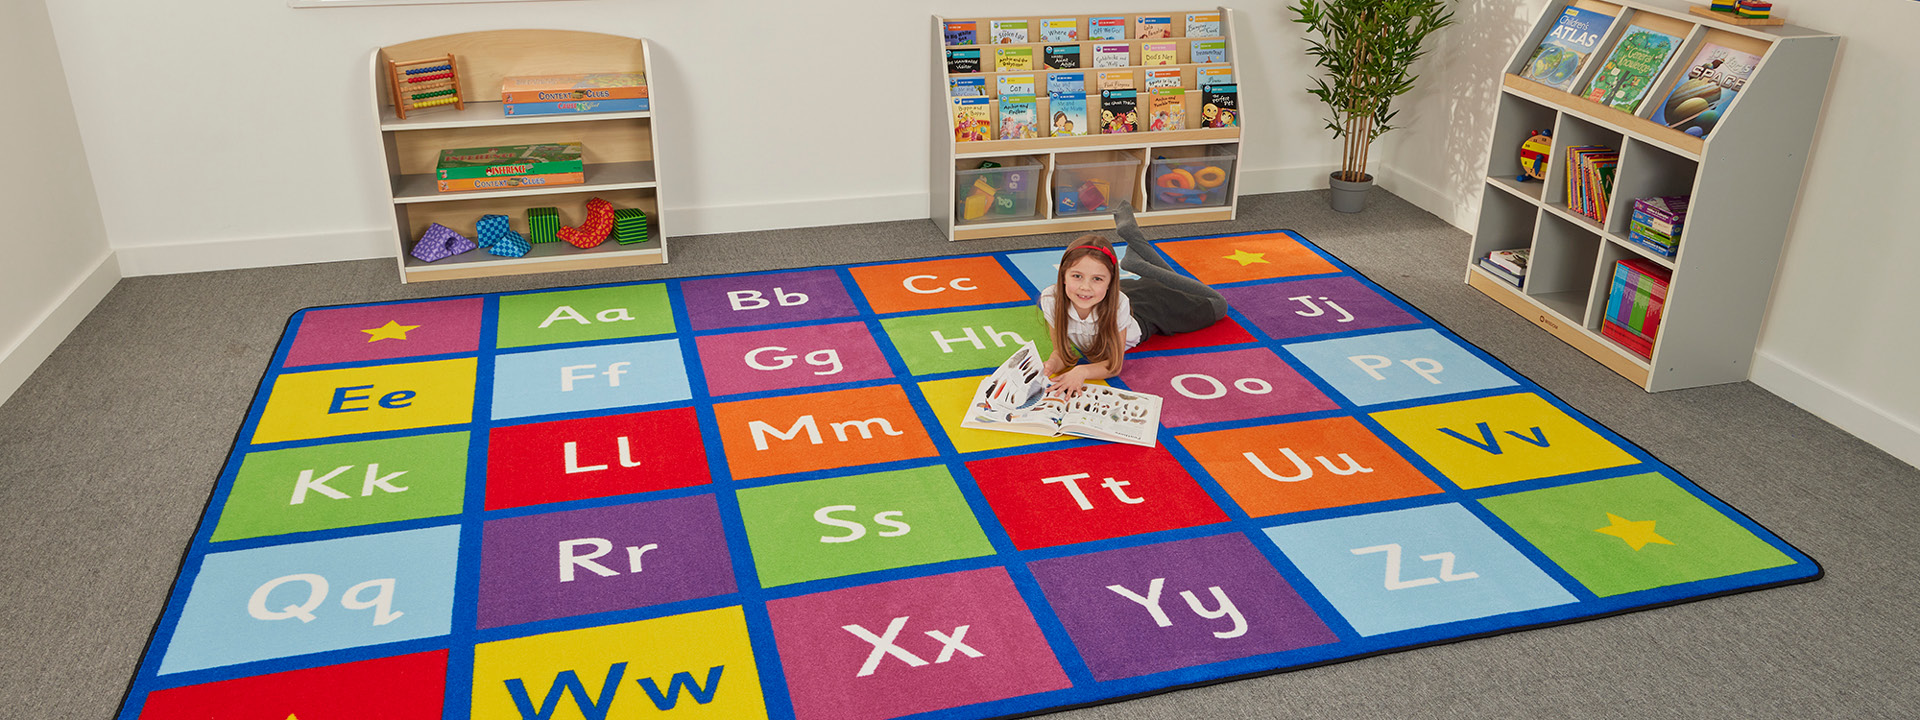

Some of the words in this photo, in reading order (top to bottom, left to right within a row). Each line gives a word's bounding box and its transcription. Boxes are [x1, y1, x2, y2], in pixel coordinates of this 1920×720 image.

[1550, 25, 1598, 47] ATLAS
[1560, 15, 1590, 30] Children's
[1628, 48, 1655, 62] General
[1709, 48, 1728, 59] 100
[1692, 65, 1747, 92] SPACE
[538, 92, 572, 100] CONTEXT
[586, 90, 610, 98] CLUES
[474, 180, 507, 188] CONTEXT
[522, 177, 545, 185] CLUES
[492, 165, 526, 175] INFERENCE
[727, 287, 809, 311] Bb
[903, 275, 977, 294] Cc
[538, 305, 635, 329] Aa
[1286, 293, 1355, 324] Jj
[929, 324, 1027, 355] Hh
[559, 360, 633, 393] Ff
[744, 346, 844, 376] Gg
[1346, 353, 1446, 386] Pp
[328, 384, 416, 415] Ee
[1170, 373, 1273, 400] Oo
[748, 415, 903, 451] Mm
[1437, 422, 1550, 455] Vv
[564, 436, 641, 474] Ll
[1243, 447, 1374, 482] Uu
[290, 463, 409, 505] Kk
[1041, 473, 1144, 510] Tt
[813, 504, 911, 543] Ss
[559, 537, 658, 583] Rr
[1349, 542, 1481, 592] Zz
[247, 572, 405, 627] Qq
[1105, 577, 1249, 639] Yy
[841, 615, 985, 677] Xx
[504, 661, 724, 720] Ww
